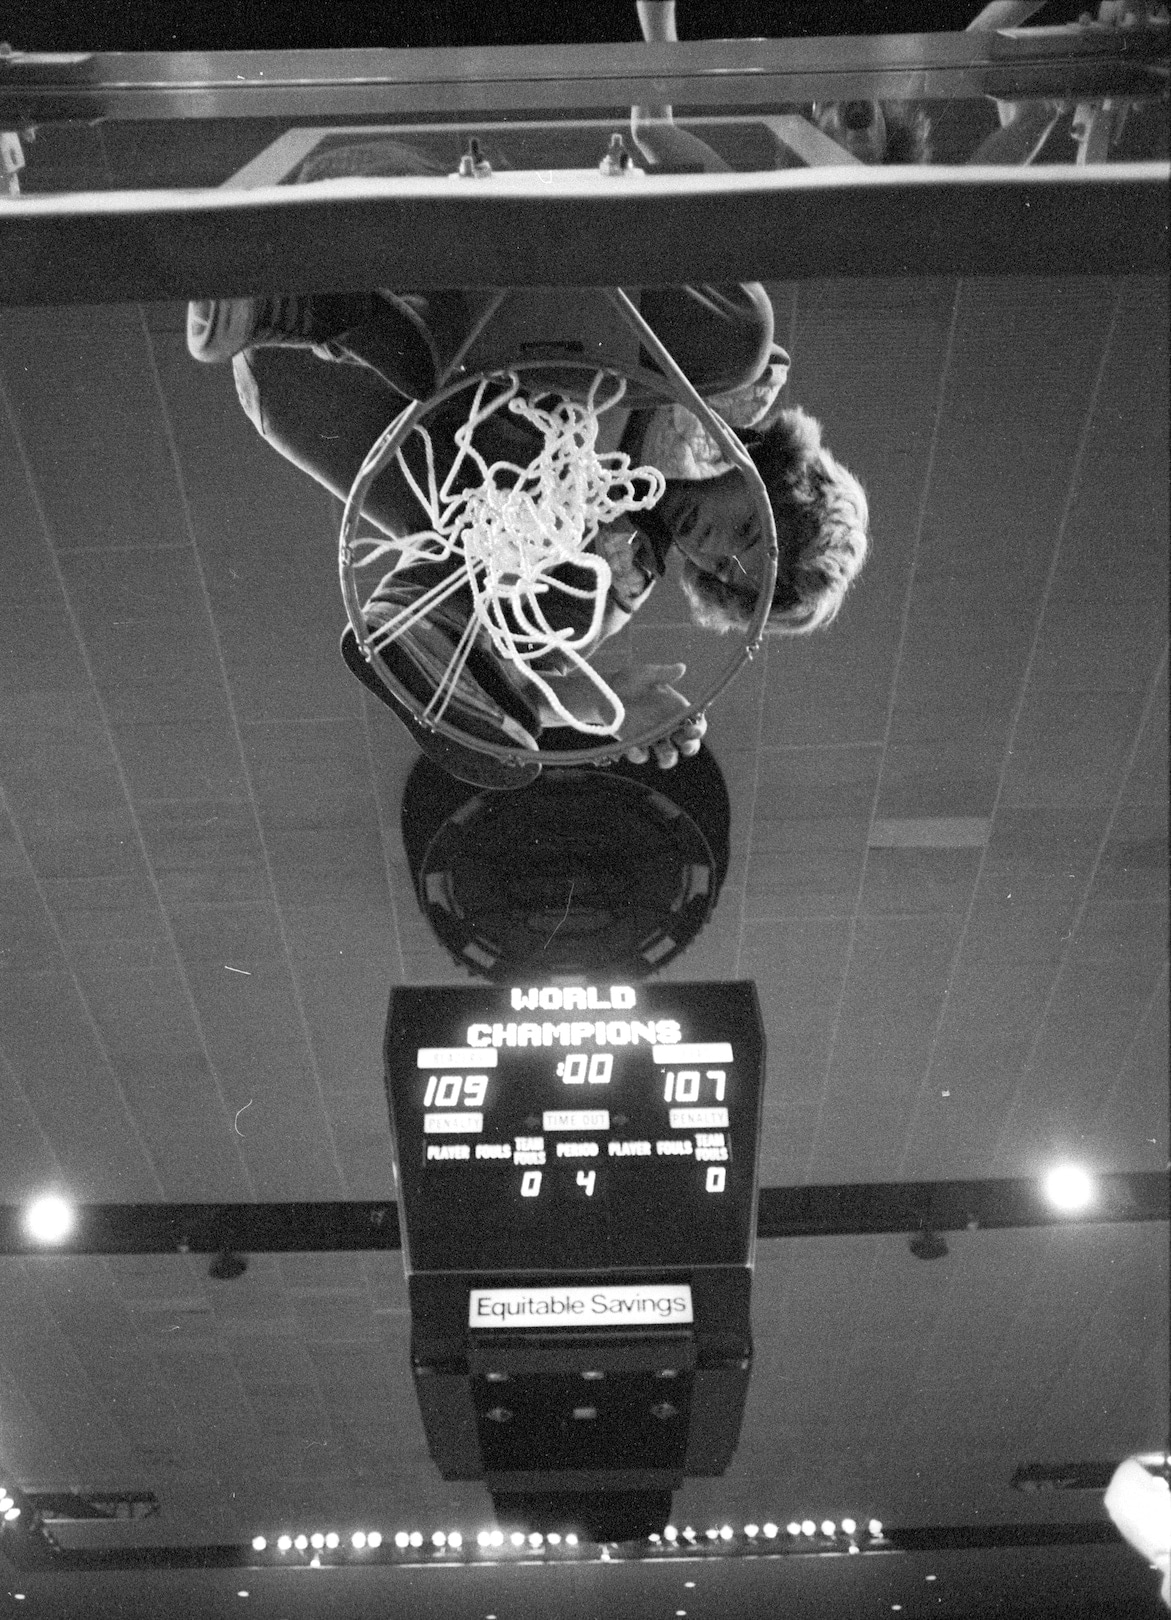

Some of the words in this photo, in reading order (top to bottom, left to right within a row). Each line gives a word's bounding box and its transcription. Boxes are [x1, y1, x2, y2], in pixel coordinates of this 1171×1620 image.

[511, 986, 636, 1010] WORLD
[467, 1020, 682, 1047] CHAMPIONS
[424, 1075, 488, 1106] 109
[664, 1071, 725, 1102] 107
[427, 1117, 480, 1129] PENALTY
[547, 1114, 576, 1126] TIME
[582, 1114, 605, 1126] OUT
[672, 1112, 724, 1125] PENALTY
[515, 1138, 544, 1150] TEAM
[609, 1142, 651, 1155] PLAYER
[657, 1141, 692, 1155] FOULS
[695, 1134, 724, 1146] TEAM
[428, 1146, 470, 1159] PLAYER
[476, 1145, 511, 1158] FOULS
[557, 1143, 598, 1157] PERIOD
[521, 1171, 542, 1196] 0
[577, 1171, 595, 1196] 4
[705, 1166, 725, 1192] 0
[477, 1295, 585, 1321] Equitable
[591, 1294, 687, 1317] Savings
